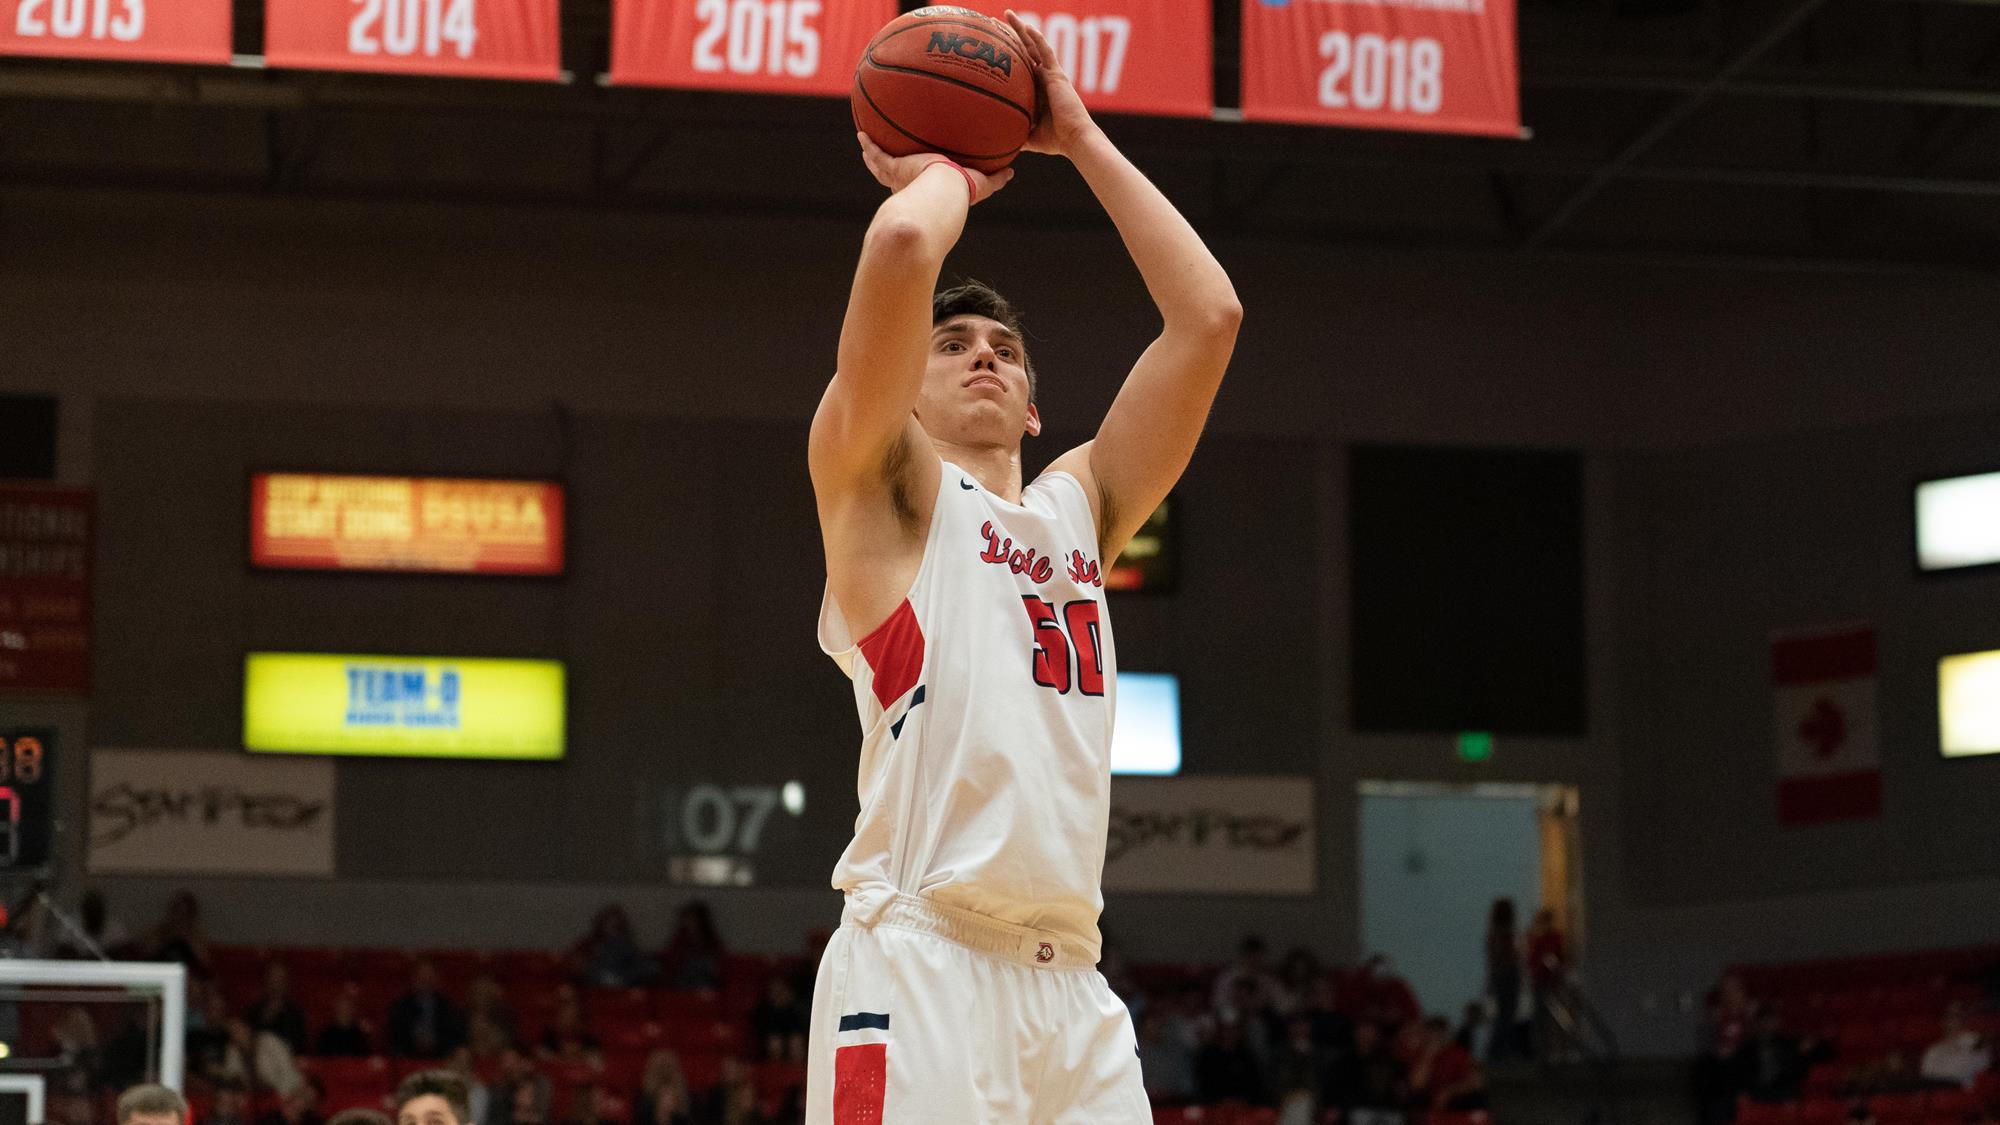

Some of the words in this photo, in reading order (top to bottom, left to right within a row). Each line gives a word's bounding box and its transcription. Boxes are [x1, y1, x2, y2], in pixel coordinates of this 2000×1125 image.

[348, 0, 477, 58] 2014
[693, 0, 821, 77] 2015
[927, 31, 1012, 78] NCAA
[1318, 31, 1443, 113] 2018
[1021, 594, 1105, 697] 50
